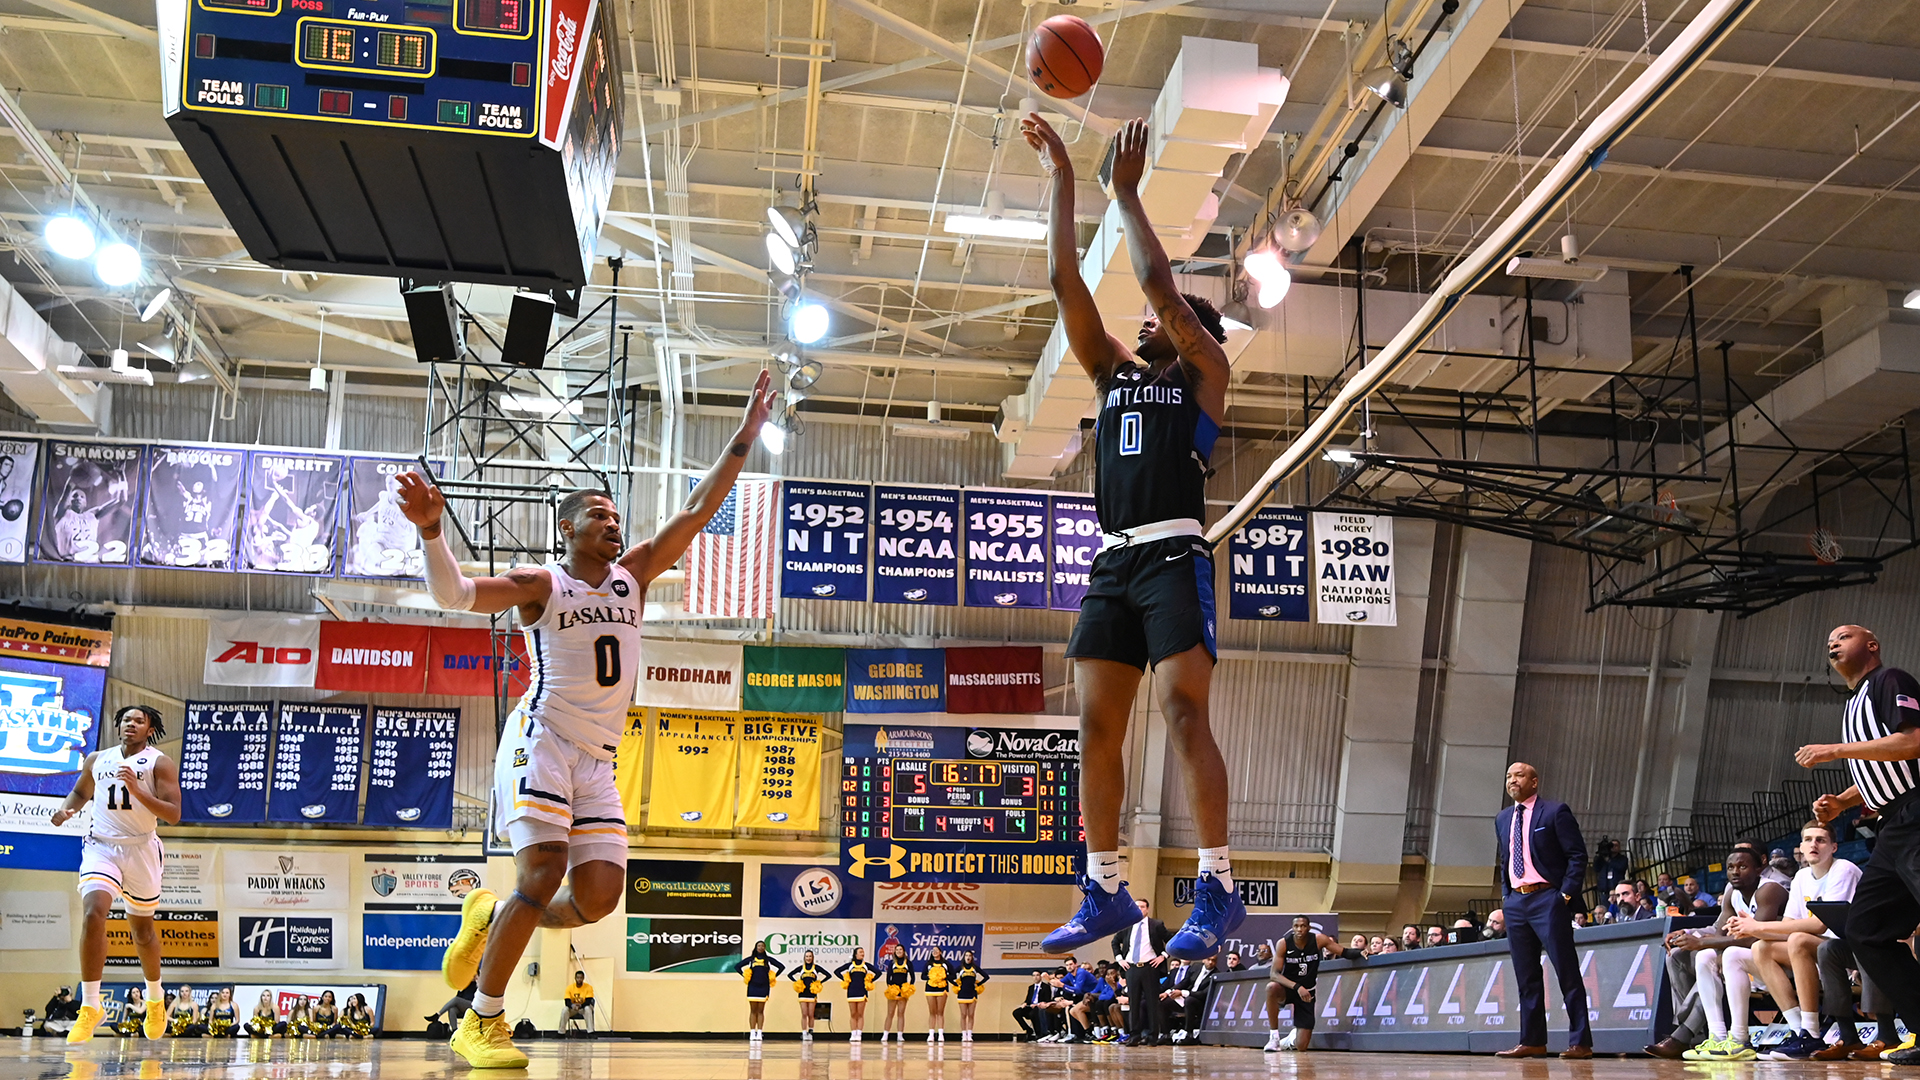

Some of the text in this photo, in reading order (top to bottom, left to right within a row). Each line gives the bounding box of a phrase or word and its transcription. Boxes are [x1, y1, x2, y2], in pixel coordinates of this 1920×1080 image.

[202, 78, 242, 93] TEAM
[198, 91, 244, 106] FOULS
[455, 104, 468, 123] 4
[482, 103, 521, 118] TEAM
[478, 115, 523, 130] FOULS
[1133, 385, 1182, 404] LOUIS
[1120, 411, 1143, 456] 0
[55, 444, 137, 461] SIMMONS
[166, 449, 233, 467] BROOKS
[262, 457, 333, 473] DURRETT
[790, 487, 865, 498] MEN'S BASKETBALL
[881, 492, 955, 503] MEN'S BASKETBALL
[970, 497, 1044, 508] MEN'S BASKETBALL
[789, 502, 865, 528] 1952
[880, 508, 954, 533] 1954
[1258, 513, 1303, 521] BASKETBALL
[1340, 516, 1366, 524] FIELD
[969, 512, 1044, 538] 1955
[1334, 525, 1373, 533] HOCKEY
[1234, 525, 1303, 551] 1987
[73, 539, 127, 563] 22
[176, 538, 229, 567] 32
[879, 537, 955, 559] NCAA
[969, 540, 1045, 563] NCAA
[1321, 537, 1390, 560] 1980
[786, 560, 864, 574] CHAMPIONS
[878, 566, 955, 578] CHAMPIONS
[1321, 563, 1390, 582] AIAW
[969, 569, 1045, 583] FINALISTS
[1234, 583, 1305, 596] FINALISTS
[1321, 585, 1391, 595] NATIONAL
[1321, 595, 1391, 604] CHAMPIONS
[43, 630, 102, 649] Painters
[212, 640, 312, 665] A10
[331, 648, 414, 667] DAVIDSON
[594, 634, 622, 688] 0
[646, 666, 732, 685] FORDHAM
[868, 663, 923, 679] GEORGE
[747, 672, 842, 688] GEORGE MASON
[950, 673, 1041, 686] MASSACHUSETTS
[853, 684, 939, 700] WASHINGTON
[189, 704, 268, 712] MEN'S BASKETBALL
[310, 706, 361, 715] BASKETBALL
[660, 712, 693, 720] WOMEN'S
[188, 722, 268, 731] APPEARANCES
[280, 724, 360, 735] APPEARANCES
[376, 717, 455, 732] BIG FIVE
[744, 723, 818, 737] BIG FIVE
[244, 734, 266, 742] 1955
[280, 734, 304, 743] 1948
[375, 729, 454, 738] CHAMPIONS
[659, 732, 734, 742] APPEARANCES
[336, 736, 360, 745] 1950
[376, 740, 397, 749] 1957
[744, 735, 817, 744] CHAMPIONSHIPS
[186, 743, 210, 752] 1968
[244, 744, 266, 752] 1975
[279, 744, 300, 752] 1951
[335, 746, 358, 754] 1952
[429, 741, 452, 750] 1964
[678, 745, 709, 756] 1992
[766, 745, 794, 756] 1987
[184, 752, 208, 762] 1978
[240, 753, 264, 761] 1980
[278, 752, 300, 762] 1953
[334, 754, 358, 764] 1963
[374, 750, 398, 758] 1969
[431, 752, 452, 760] 1975
[238, 762, 264, 770] 1988
[374, 758, 395, 768] 1981
[428, 760, 452, 769] 1984
[764, 756, 796, 765] 1988
[183, 762, 208, 771] 1983
[276, 762, 300, 772] 1965
[336, 764, 357, 773] 1971
[763, 766, 794, 777] 1989
[896, 762, 926, 771] LASALLE
[1002, 765, 1036, 774] VISITOR
[182, 771, 208, 781] 1989
[239, 772, 264, 781] 1990
[332, 773, 356, 783] 1987
[372, 768, 396, 778] 1989
[428, 770, 451, 778] 1990
[180, 781, 206, 790] 1992
[239, 782, 262, 790] 2013
[274, 782, 297, 790] 1991
[372, 779, 394, 788] 2013
[762, 778, 792, 788] 1992
[914, 774, 926, 794] 5
[1022, 777, 1034, 796] 3
[107, 784, 132, 810] 11
[762, 789, 792, 799] 1998
[1001, 798, 1022, 806] BONUS
[936, 816, 947, 831] 4
[984, 817, 994, 832] 4
[1016, 818, 1025, 832] 4
[910, 852, 1076, 875] PROTECT THIS HOUSE
[248, 877, 326, 890] PADDY WHACKS
[404, 880, 439, 888] SPORTS
[1249, 883, 1276, 901] EXIT
[803, 892, 835, 908] PHILLY
[881, 902, 980, 912] Transportation
[161, 929, 216, 940] Klothes
[290, 926, 330, 934] Holiday Inn
[290, 934, 330, 946] Express
[633, 931, 742, 947] enterprise
[764, 931, 859, 955] Garrison
[910, 932, 977, 947] SHERWIN
[1305, 954, 1318, 962] LOUIS
[1298, 964, 1308, 976] 3
[1484, 1015, 1505, 1026] ACTION
[1858, 1027, 1875, 1038] 98
